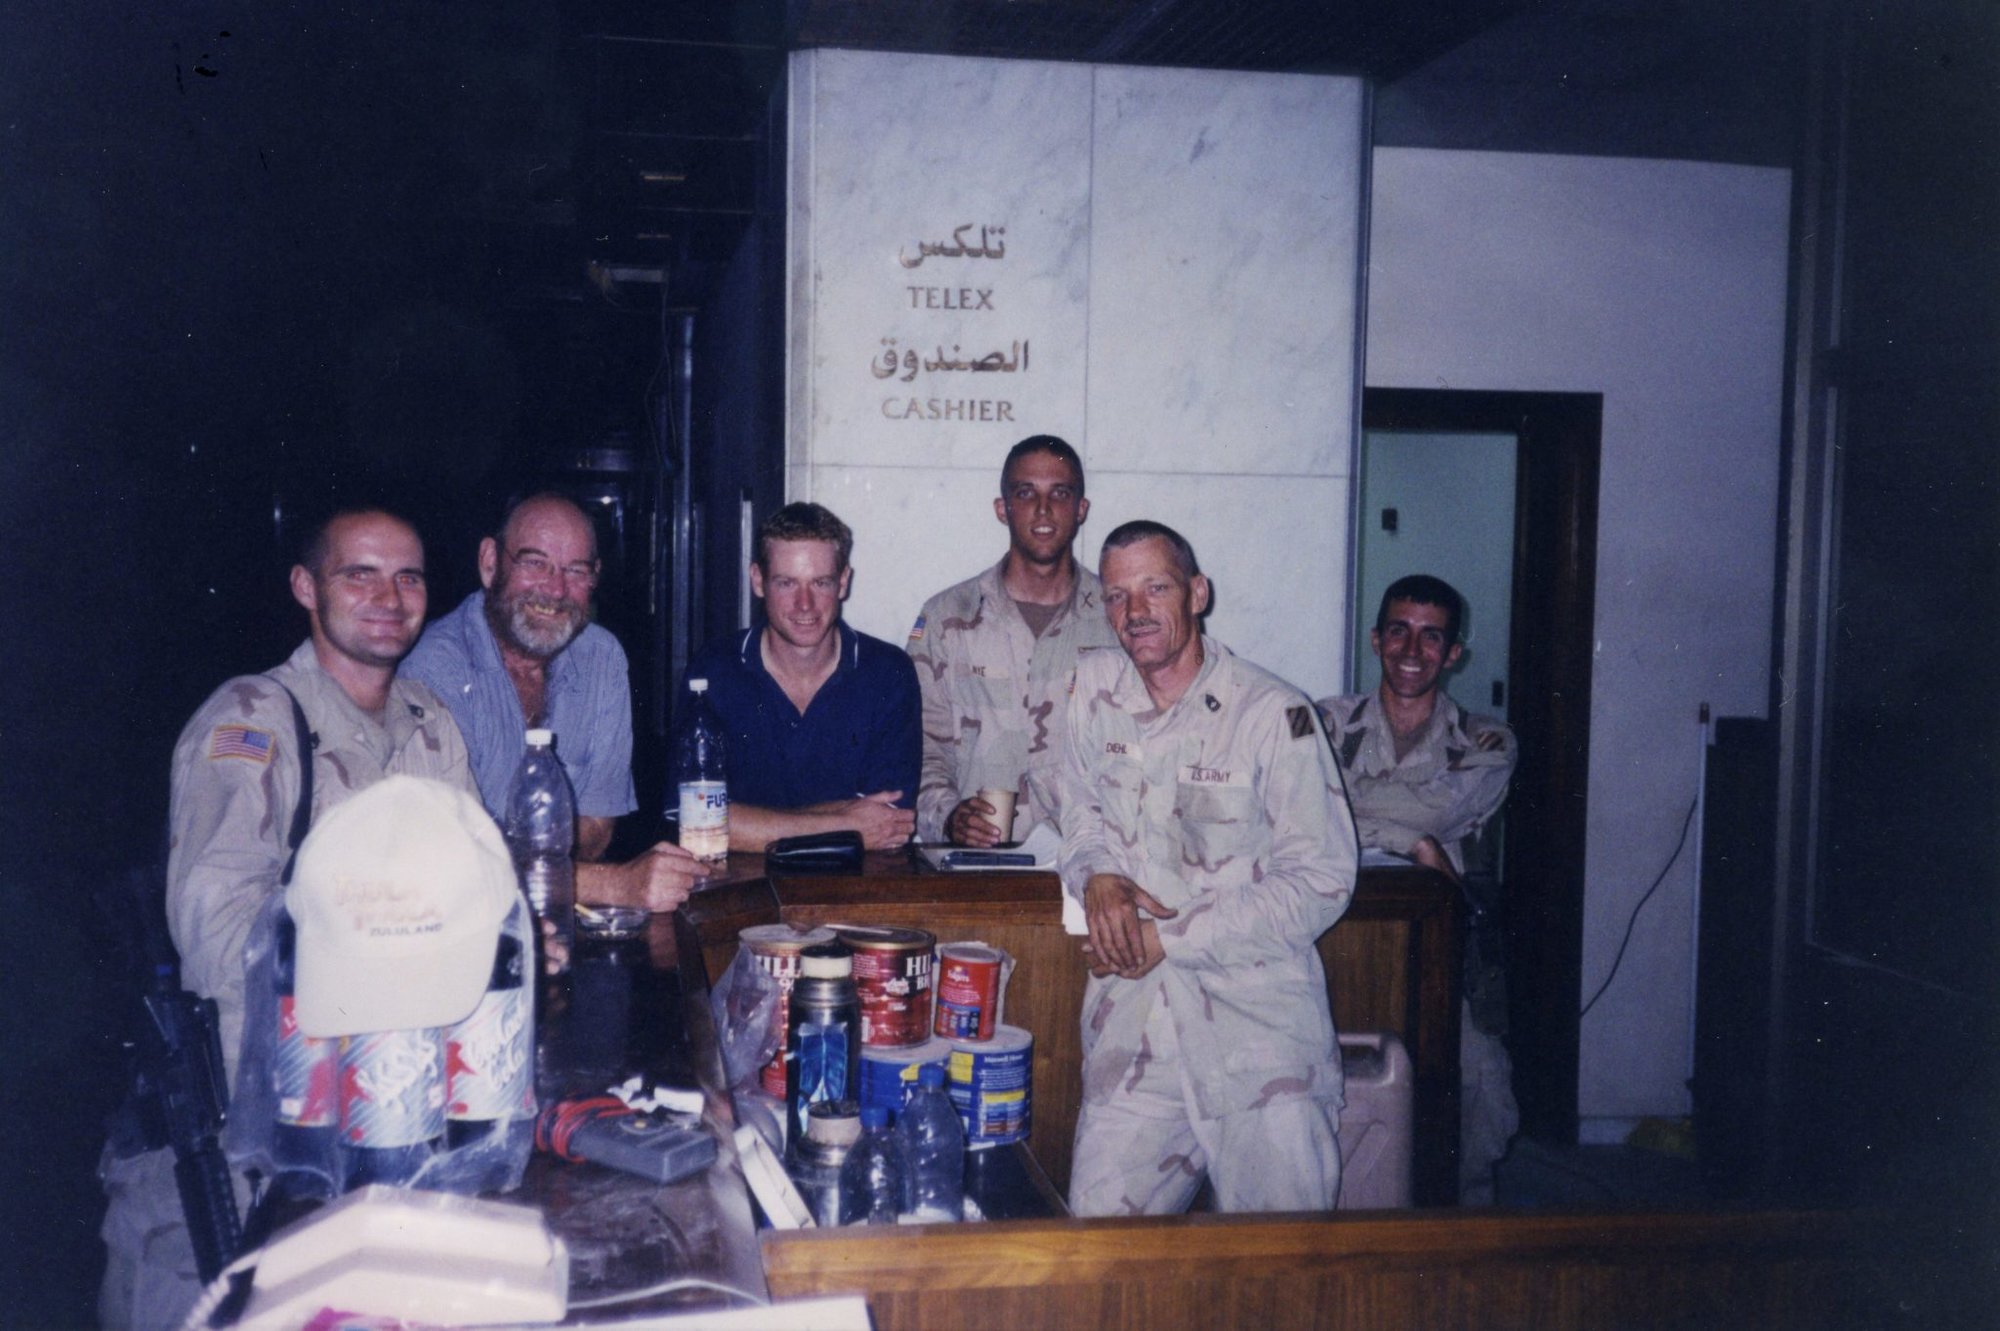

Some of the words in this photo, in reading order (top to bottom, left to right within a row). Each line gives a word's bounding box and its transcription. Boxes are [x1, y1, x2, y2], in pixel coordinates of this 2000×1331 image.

[900, 223, 1005, 269] تلكس
[907, 286, 994, 310] TELEX
[870, 338, 1029, 382] الصندوق
[881, 398, 1015, 422] CASHIER
